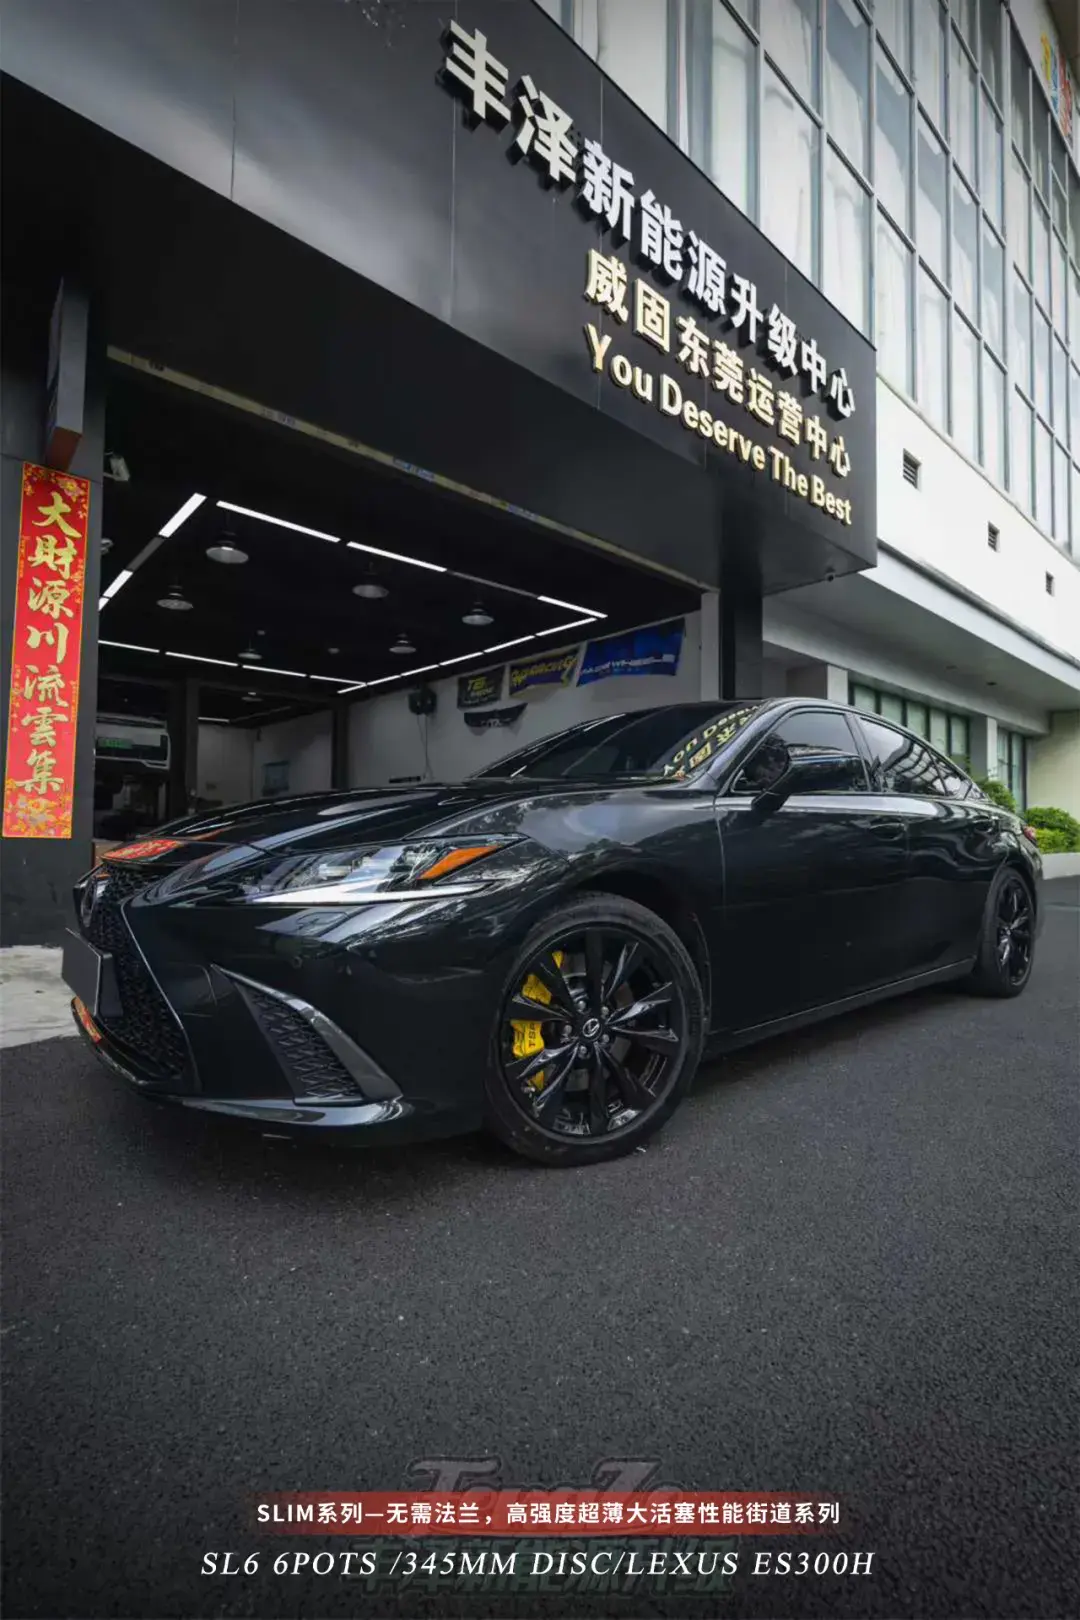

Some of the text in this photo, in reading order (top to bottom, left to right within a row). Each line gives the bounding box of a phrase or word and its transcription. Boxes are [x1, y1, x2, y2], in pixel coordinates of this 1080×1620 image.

[444, 19, 856, 418] 丰泽新能源升级中心
[584, 248, 852, 478] 威固东莞运营中心
[584, 323, 852, 526] You Deserve The Best
